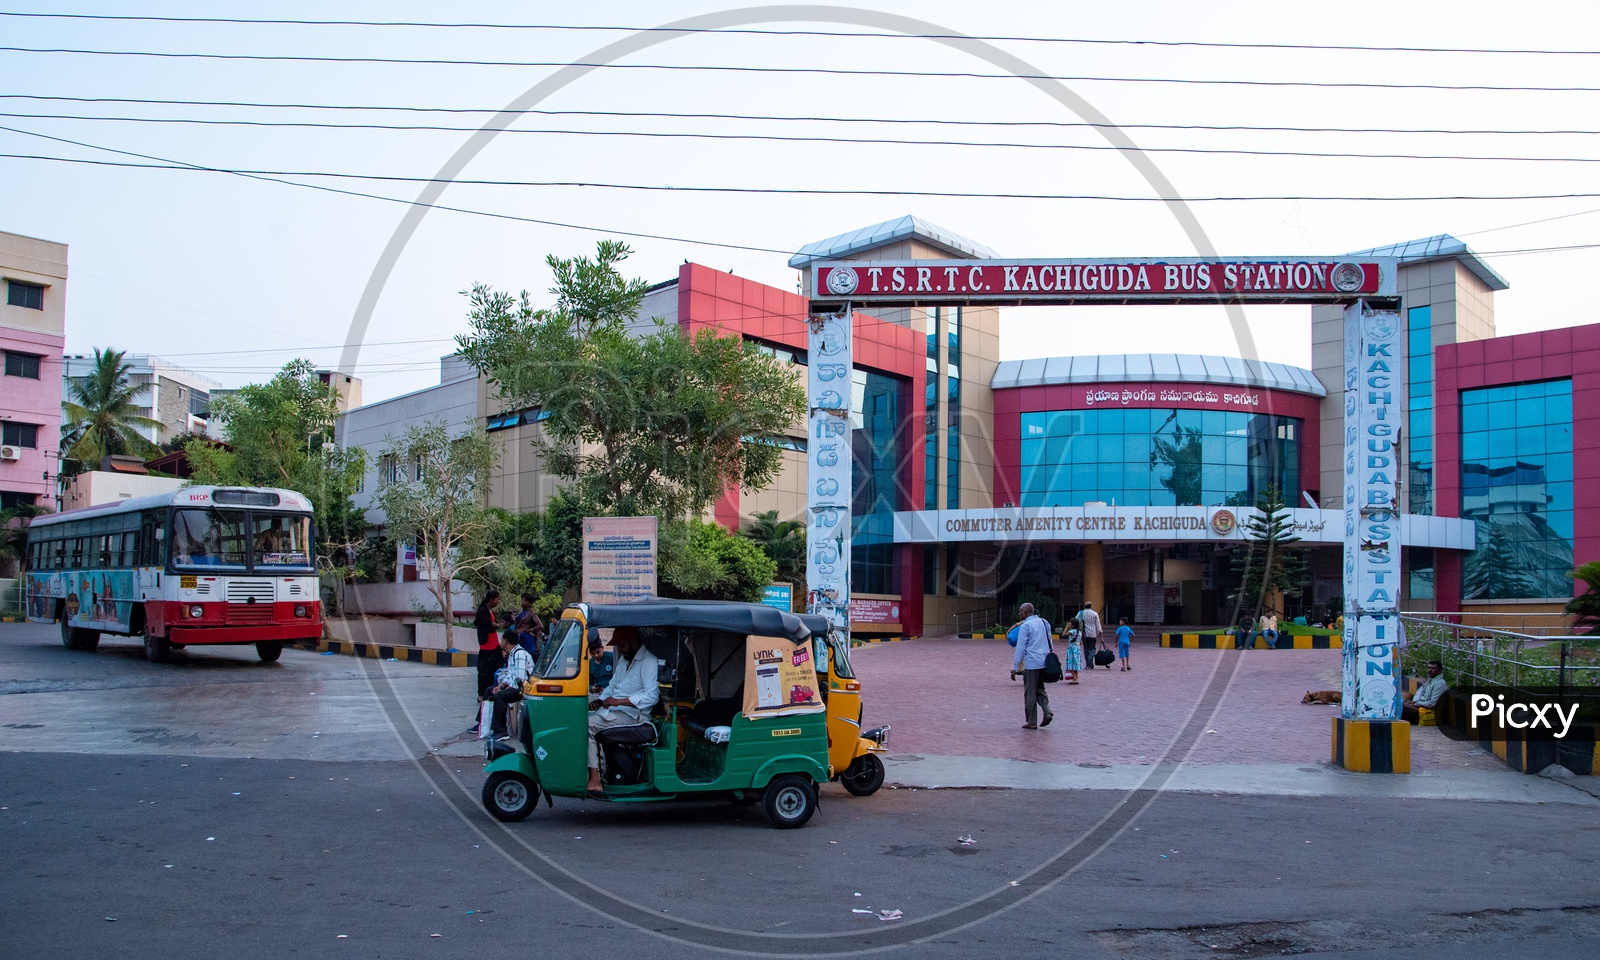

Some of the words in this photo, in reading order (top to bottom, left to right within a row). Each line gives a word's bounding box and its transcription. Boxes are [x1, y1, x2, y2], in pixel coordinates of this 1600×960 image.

[867, 266, 991, 292] T.S.R.T.C.
[1003, 265, 1151, 292] KACHIGUDA
[1163, 264, 1211, 291] BUS
[1223, 264, 1327, 291] STATION
[1086, 389, 1119, 405] ప్రయాణ
[1121, 389, 1156, 405] ప్రాంగణ
[1159, 389, 1219, 403] సముదాయము
[1223, 392, 1259, 406] కాచిగూడ
[1366, 343, 1392, 485] KACHIGUDA
[945, 518, 1013, 533] COMMUTER
[1015, 517, 1073, 532] AMENITY
[1075, 516, 1126, 531] CENTRE
[1133, 516, 1207, 531] KACHIGUDA
[793, 653, 808, 664] FREE!
